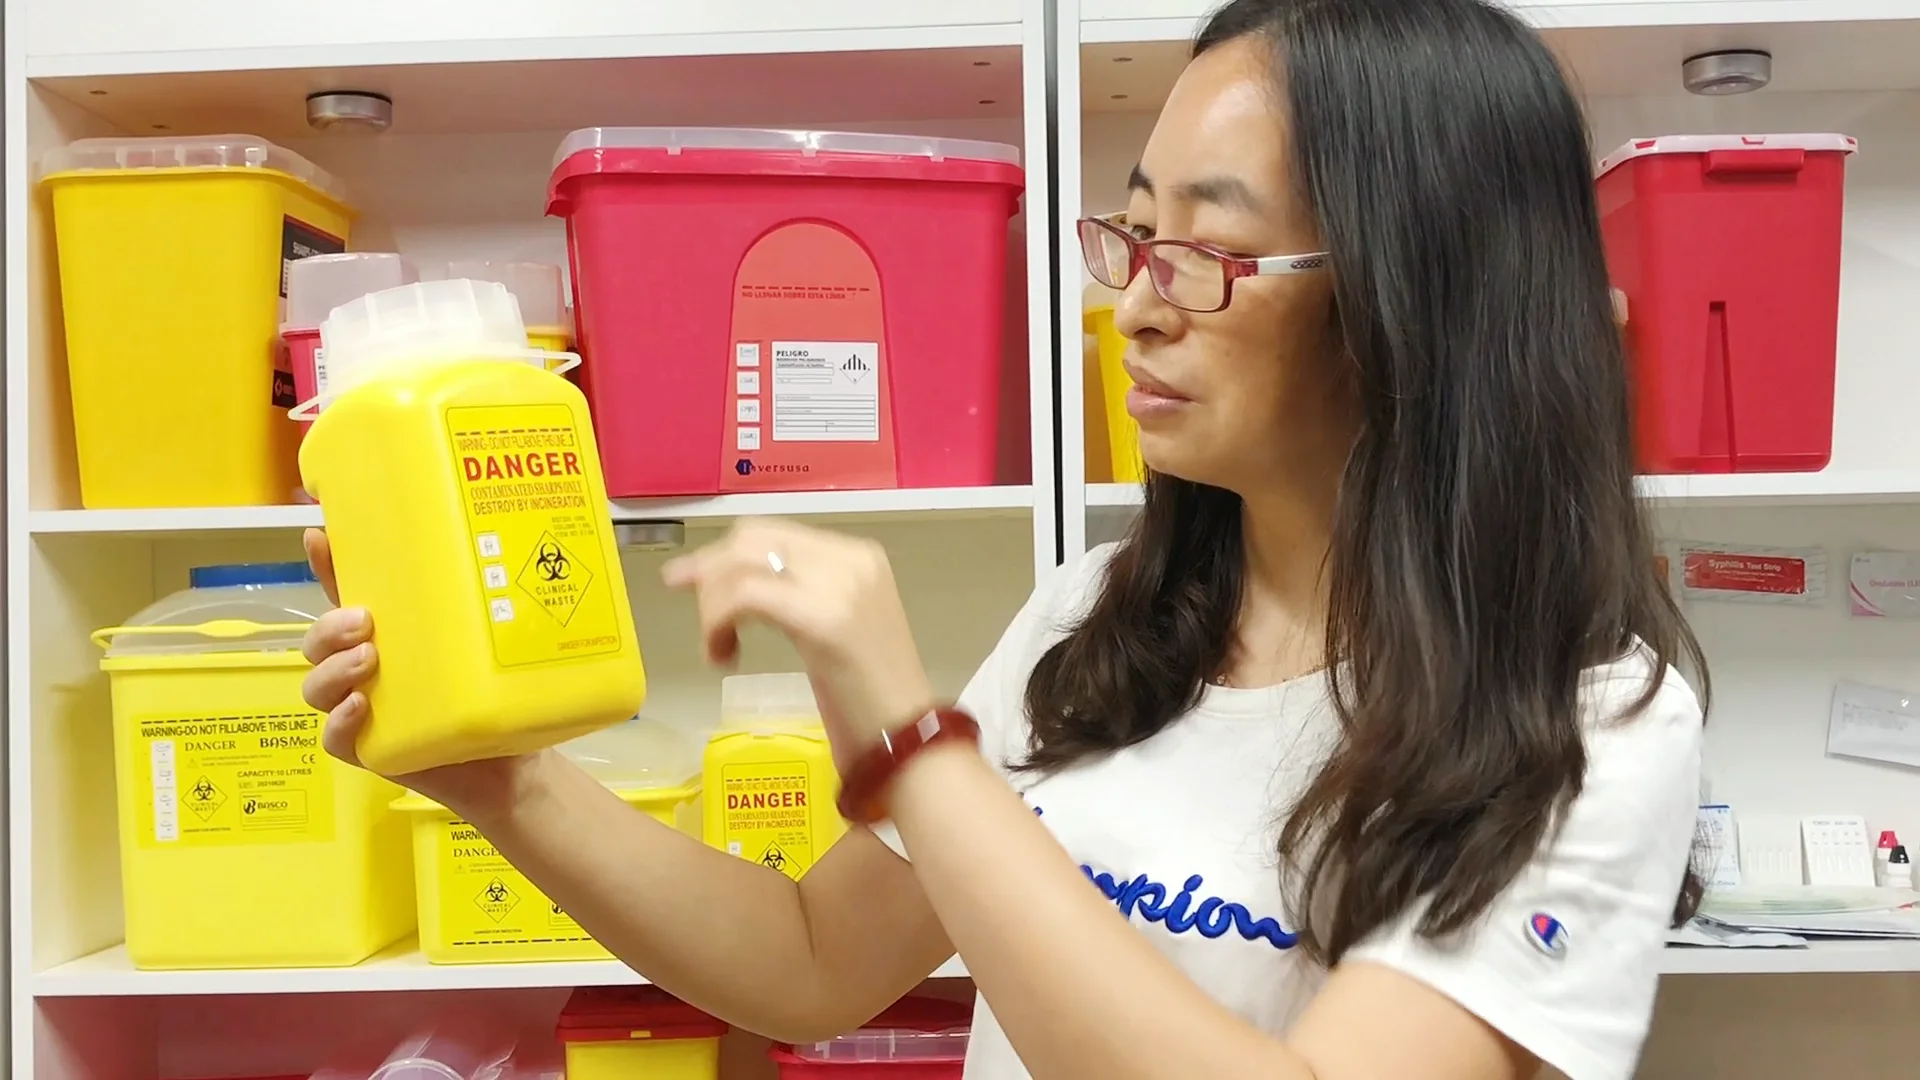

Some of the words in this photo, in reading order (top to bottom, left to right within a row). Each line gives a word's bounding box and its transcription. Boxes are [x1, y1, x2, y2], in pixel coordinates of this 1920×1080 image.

[463, 452, 581, 482] DANGER
[473, 499, 515, 516] DESTROY
[517, 498, 528, 512] BY
[530, 495, 587, 511] INCINERATION
[1763, 563, 1782, 572] Strip
[535, 584, 579, 597] CLINICAL
[543, 595, 576, 607] WASTE
[199, 724, 217, 735] NOT
[268, 720, 287, 732] THIS
[289, 719, 308, 731] LINE
[184, 740, 237, 752] DANGER
[286, 768, 312, 777] LITRES
[728, 791, 806, 809] DANGER
[729, 821, 756, 830] DESTROY
[757, 821, 765, 830] BY
[765, 819, 806, 829] INCINERATION
[453, 848, 502, 858] DANGE
